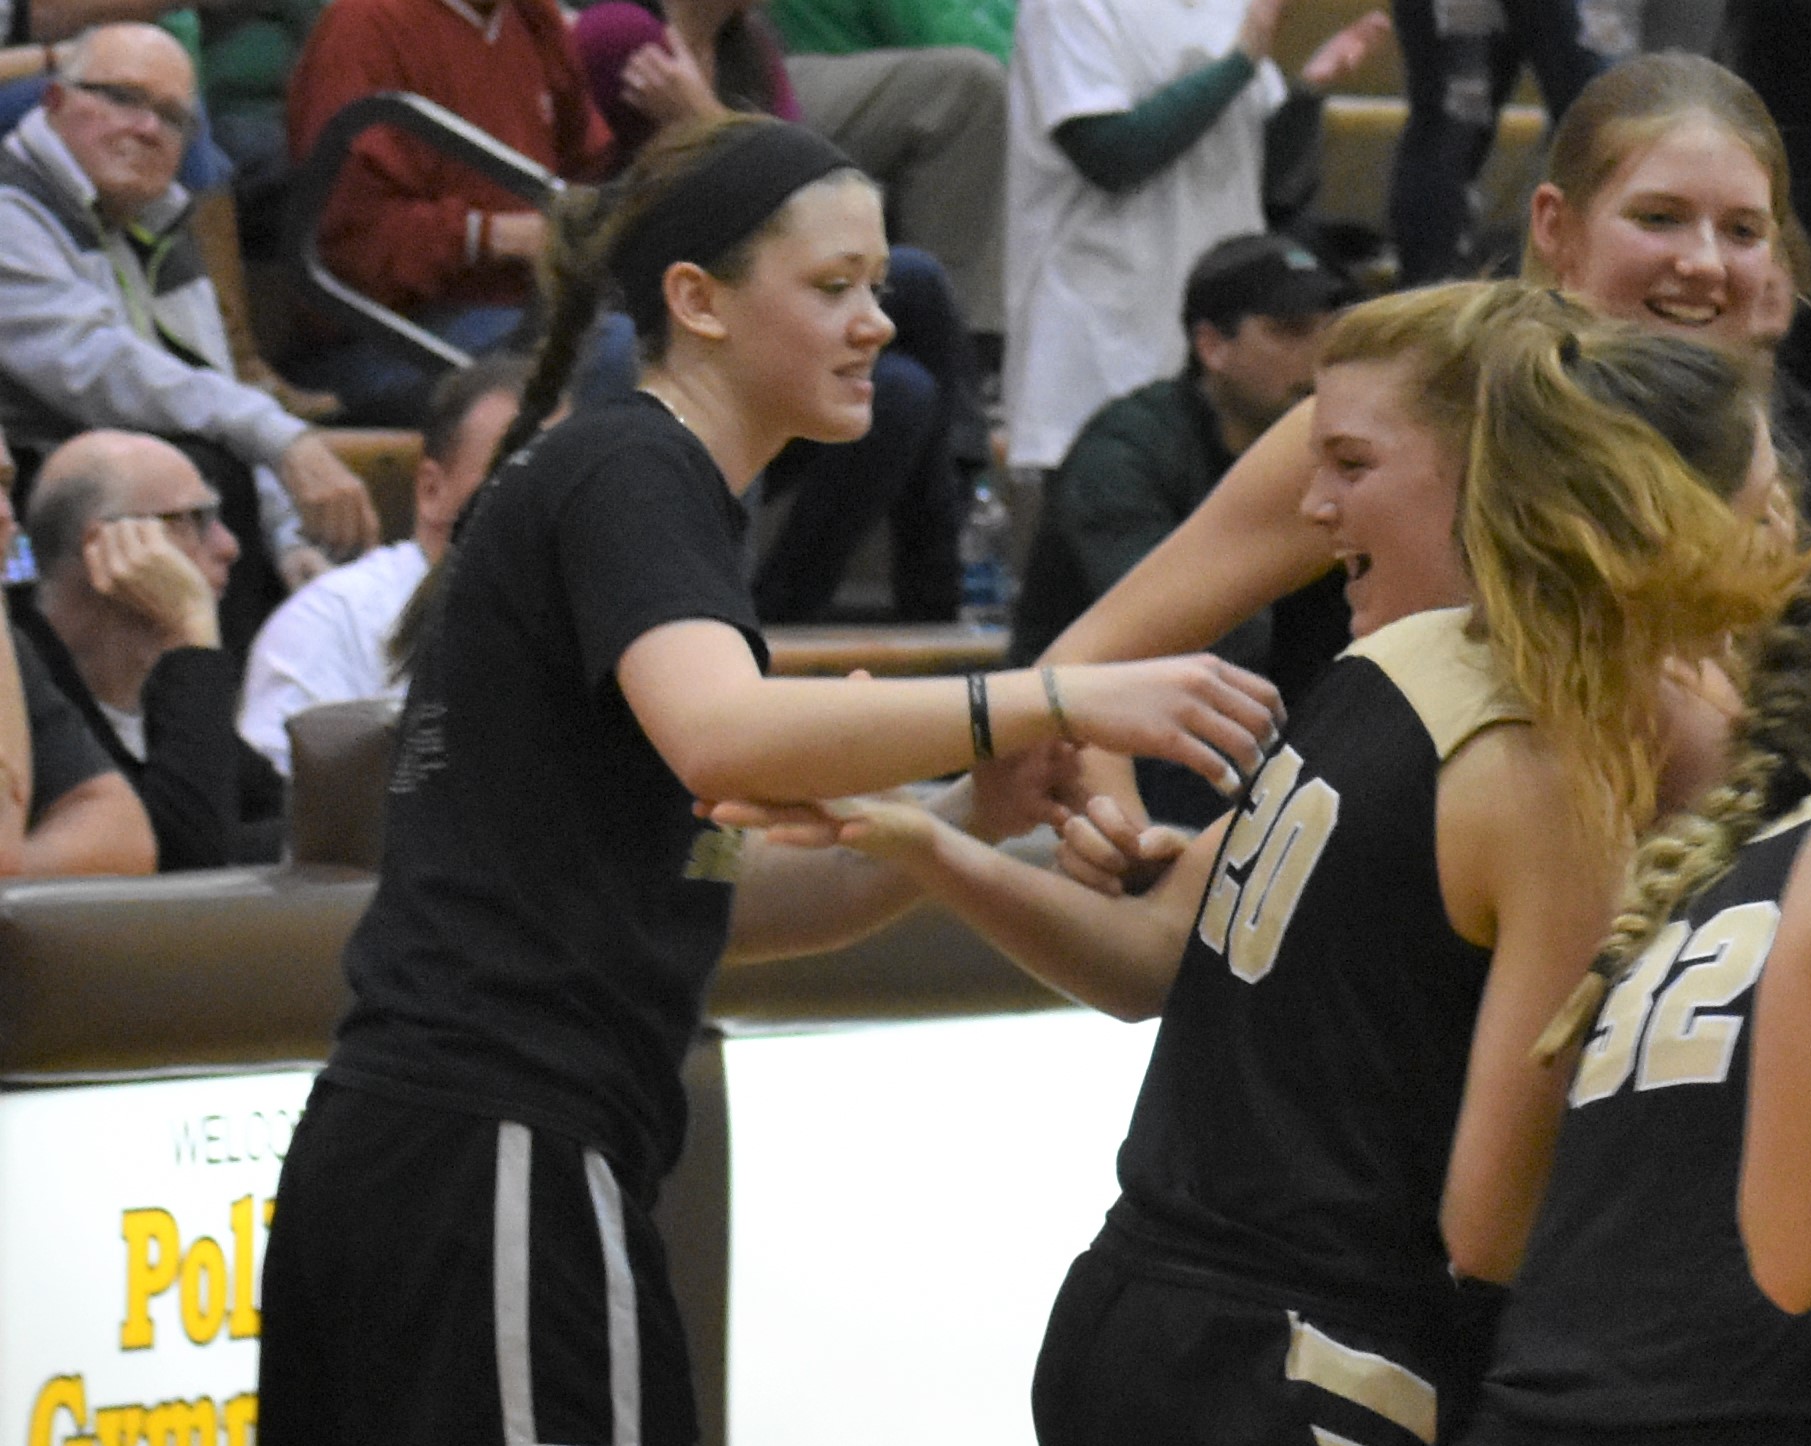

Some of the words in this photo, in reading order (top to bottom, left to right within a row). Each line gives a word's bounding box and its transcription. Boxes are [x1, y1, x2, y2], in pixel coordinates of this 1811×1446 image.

[1198, 743, 1341, 985] 20
[1568, 900, 1782, 1109] 32
[169, 1108, 306, 1167] WELCO
[119, 1193, 276, 1352] Pol
